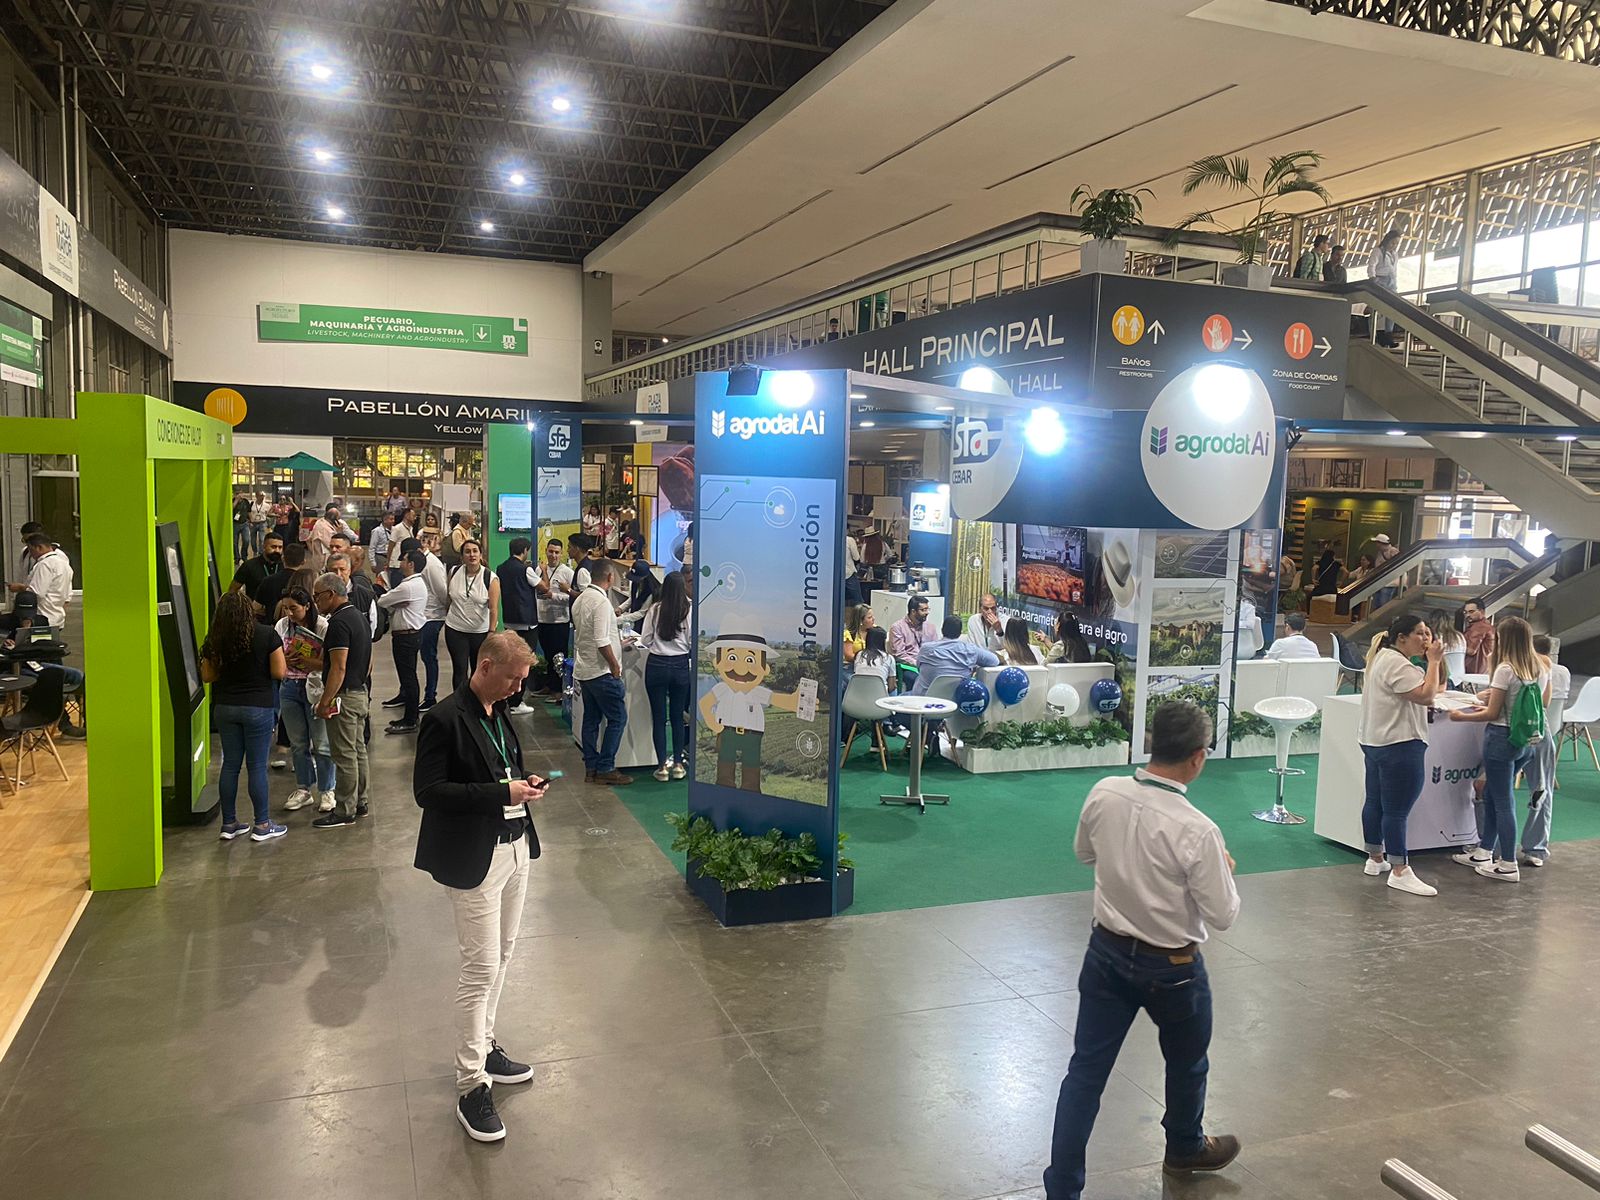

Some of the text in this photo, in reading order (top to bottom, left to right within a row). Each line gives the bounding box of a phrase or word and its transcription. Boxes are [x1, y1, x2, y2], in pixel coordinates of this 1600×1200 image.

[309, 320, 375, 330] MAQUINARIA
[386, 325, 464, 336] AGROINDUSTRIA
[363, 315, 416, 326] PECUARIO,
[307, 329, 350, 338] LIVESTOCK,
[413, 335, 469, 344] AGROINDUSTRY
[863, 314, 1065, 376] HALL PRINCIPAL
[1121, 357, 1151, 367] BAÑOS
[1018, 373, 1063, 393] HALL
[1272, 369, 1293, 378] ZONA
[1304, 372, 1338, 382] COMIDAS
[327, 397, 449, 418] PABELLÓN
[434, 424, 483, 435] YELLOW
[799, 503, 821, 661] Información
[1079, 623, 1093, 636] ara
[1095, 624, 1104, 638] el
[1105, 628, 1128, 644] agro
[1444, 762, 1481, 784] agrod
